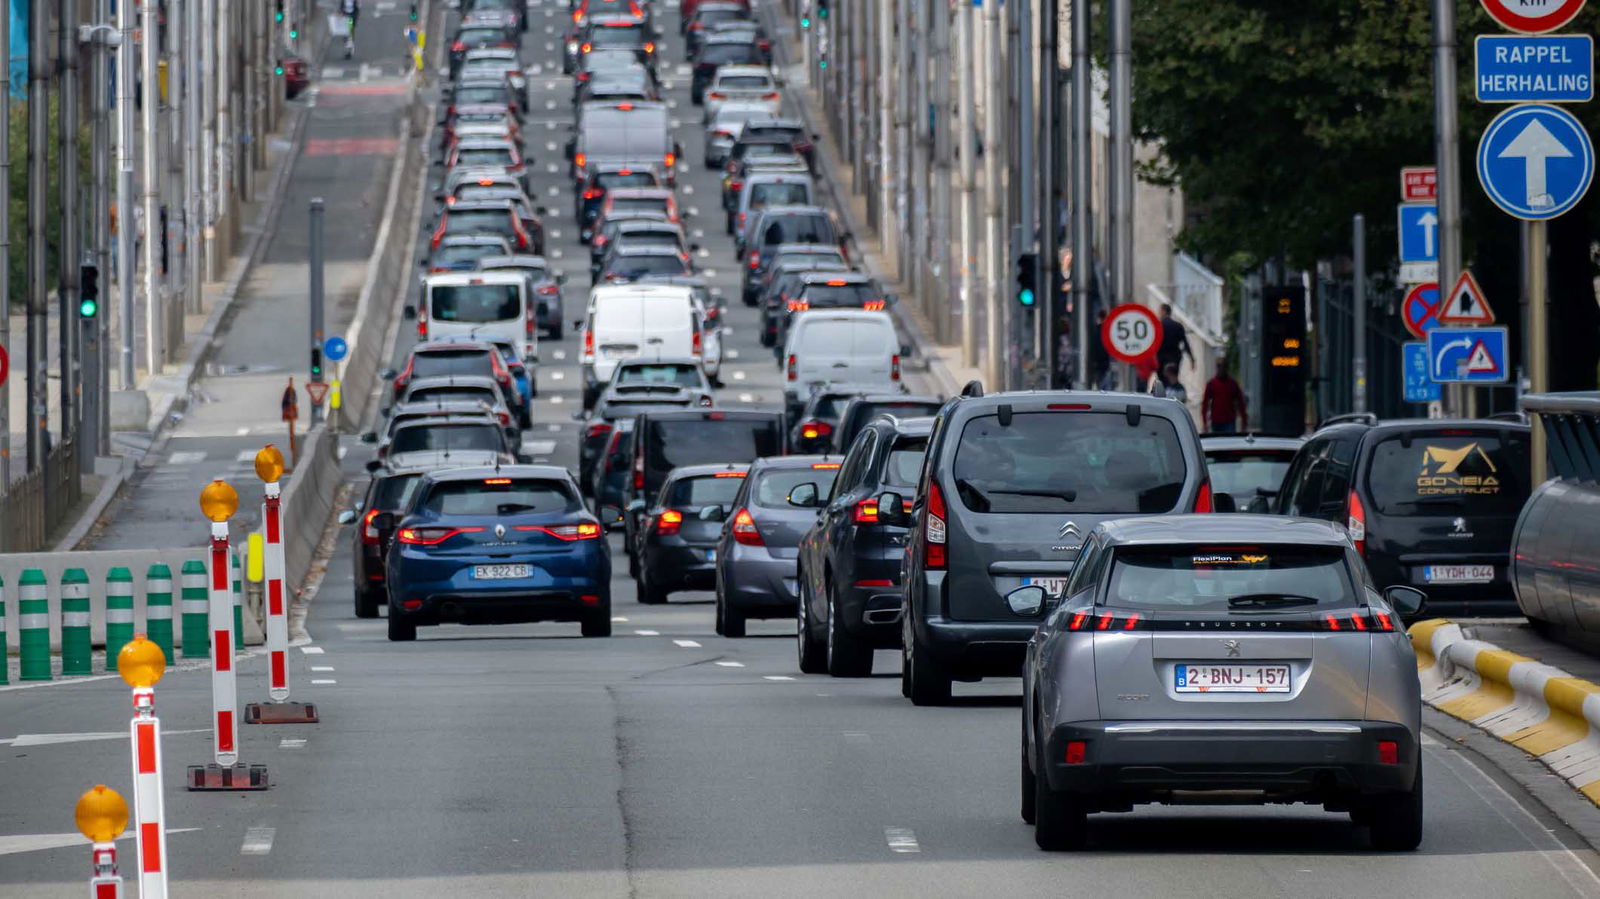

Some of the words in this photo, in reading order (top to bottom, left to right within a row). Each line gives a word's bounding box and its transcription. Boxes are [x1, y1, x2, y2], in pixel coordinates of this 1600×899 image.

[1495, 46, 1572, 63] RAPPEL
[1481, 74, 1589, 92] HERHALING
[1117, 320, 1148, 340] 50
[1417, 487, 1500, 495] CONSTRUCT
